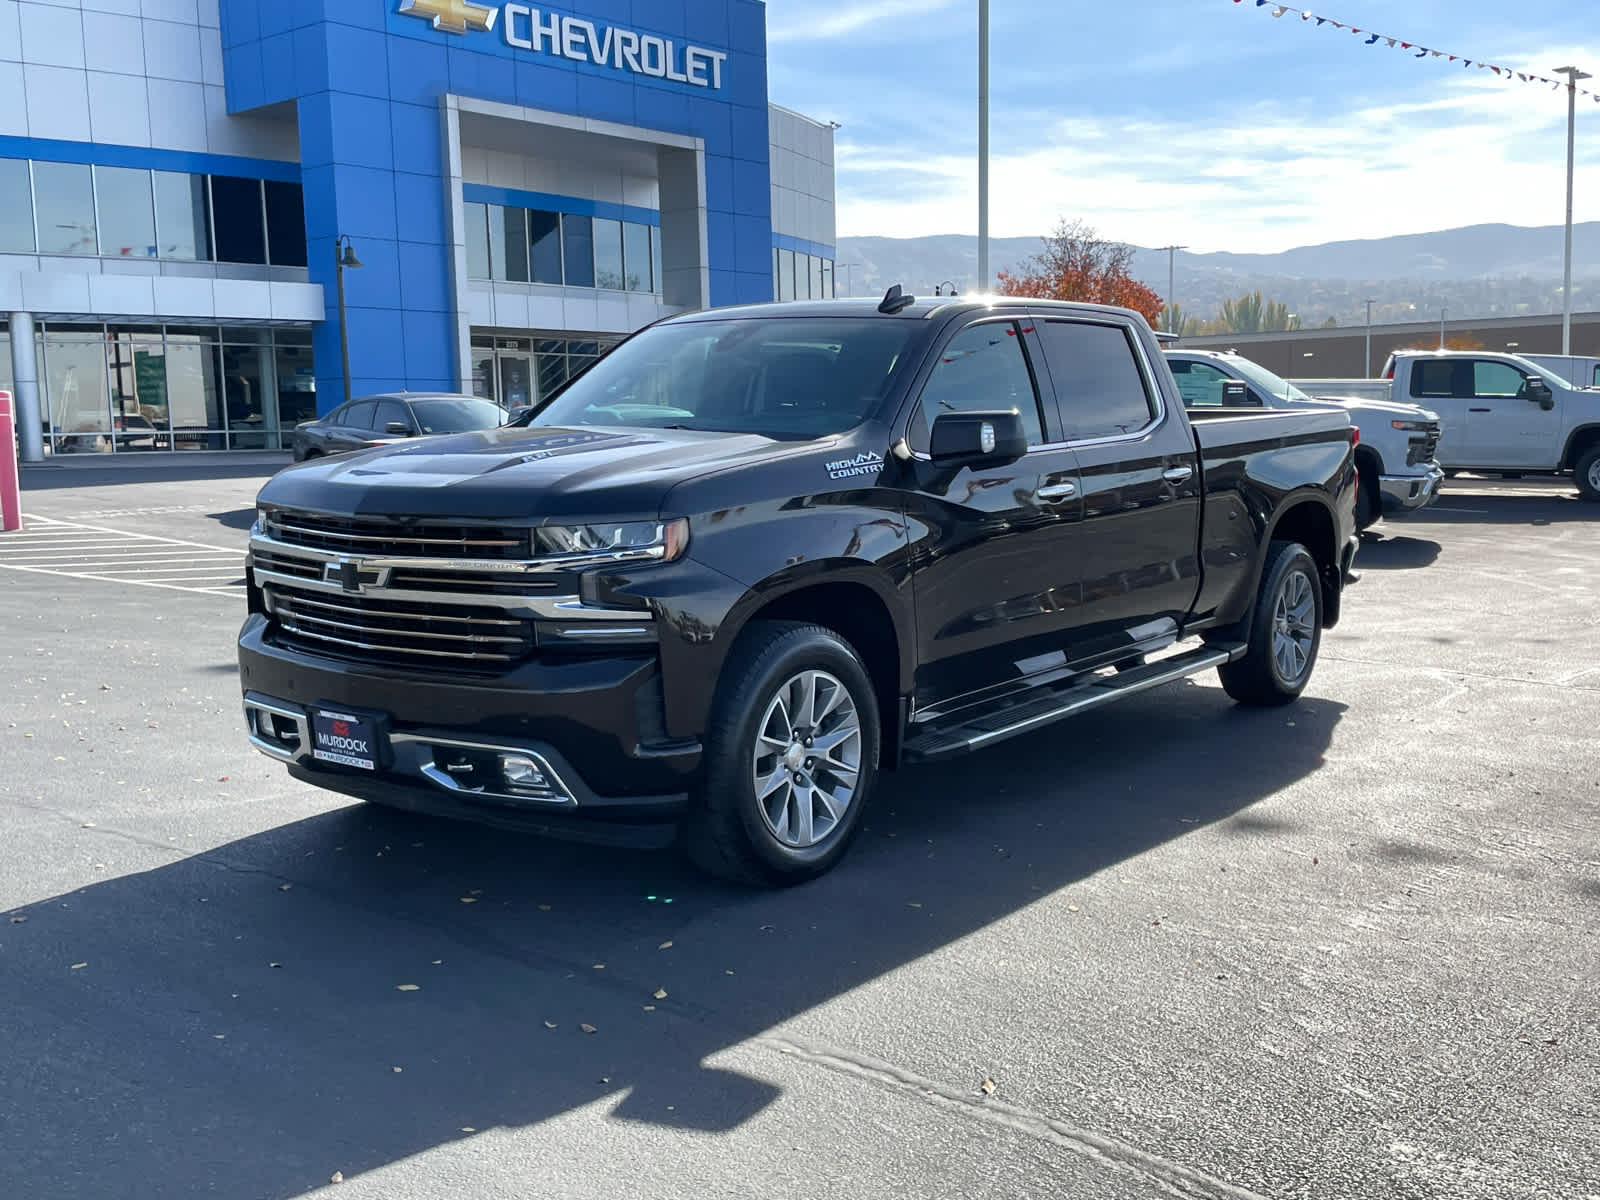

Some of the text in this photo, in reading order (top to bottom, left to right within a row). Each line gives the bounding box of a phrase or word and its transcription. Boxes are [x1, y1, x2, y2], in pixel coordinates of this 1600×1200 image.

[504, 3, 727, 89] CHEVROLET
[825, 459, 856, 471] HIGH
[830, 463, 885, 480] COUNTRY
[318, 732, 369, 753] MURDOCK
